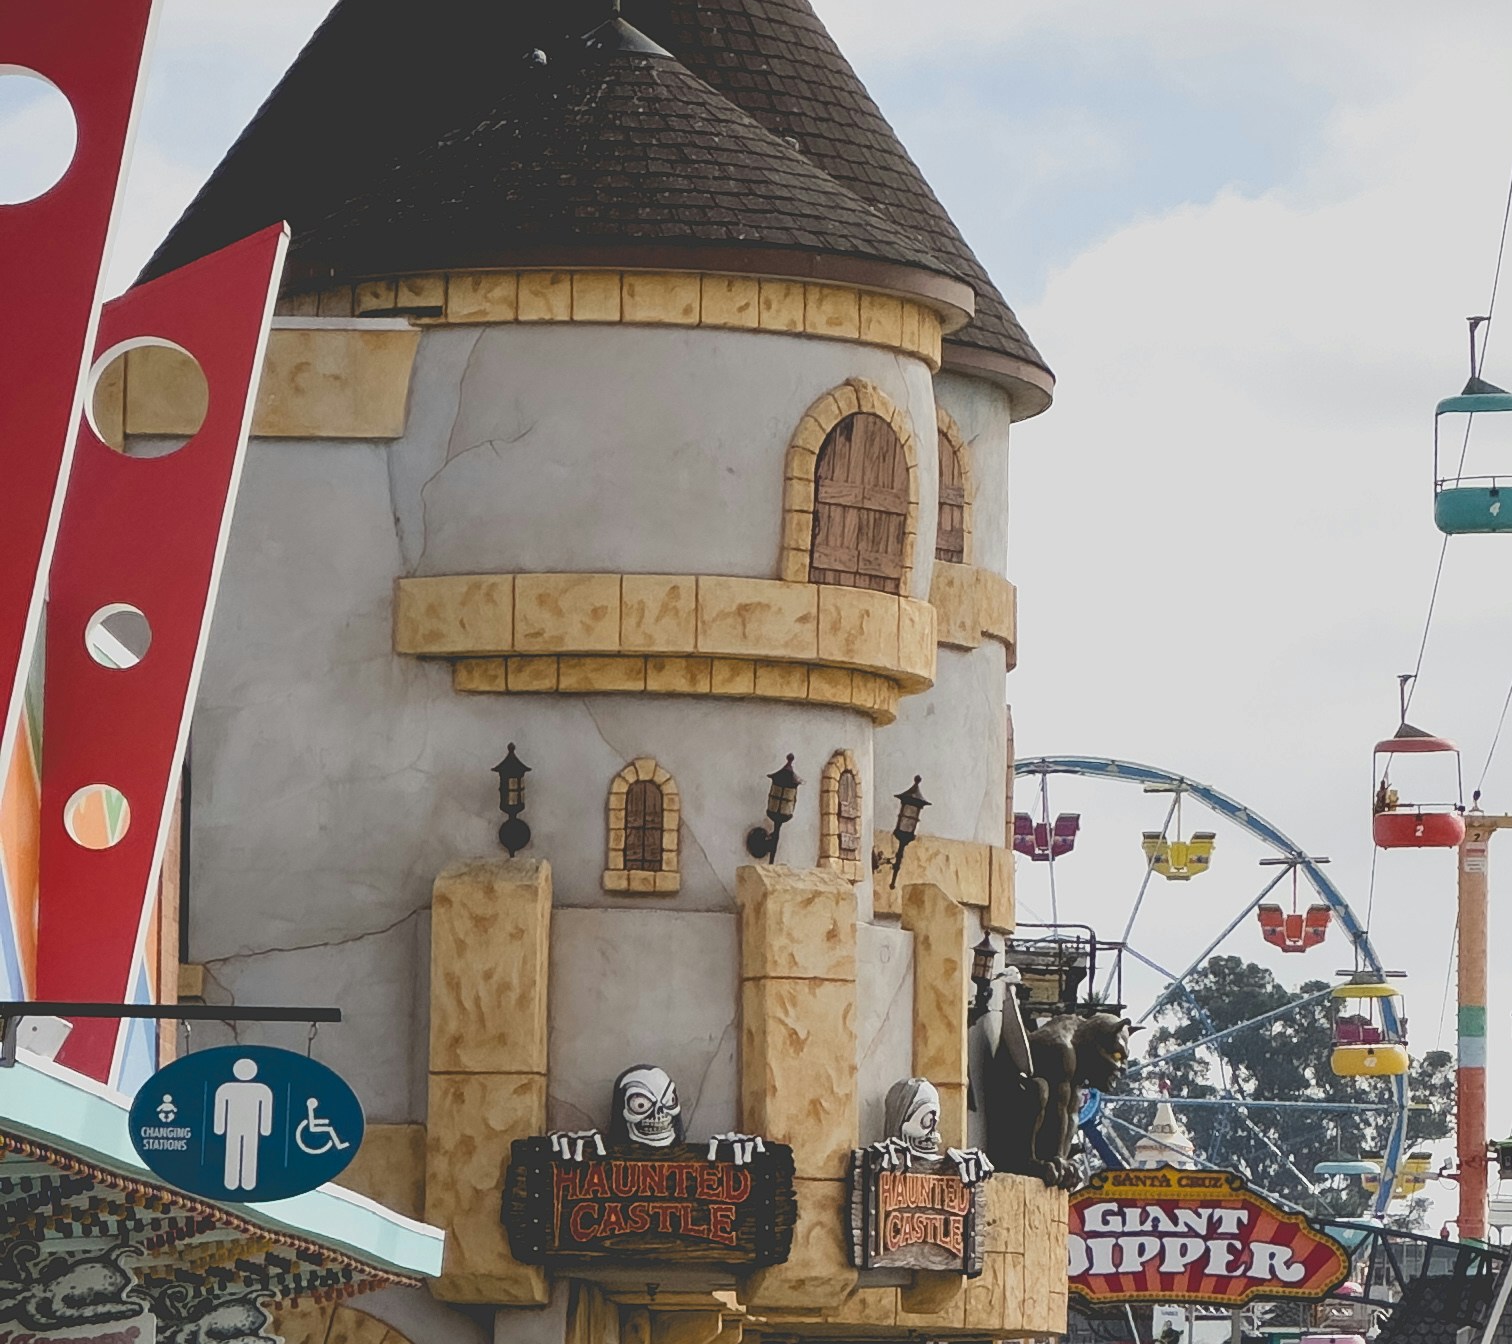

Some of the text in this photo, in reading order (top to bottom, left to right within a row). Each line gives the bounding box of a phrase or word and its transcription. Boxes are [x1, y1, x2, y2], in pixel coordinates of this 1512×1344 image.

[1415, 825, 1424, 837] 2
[141, 1126, 192, 1139] CHANGING
[143, 1139, 188, 1151] STATIONS
[551, 1161, 752, 1207] HAUNTED
[880, 1171, 970, 1216] HAUNTED
[1111, 1173, 1223, 1189] SANTA CRUZ
[570, 1202, 737, 1246] CASTLE
[887, 1211, 964, 1257] CASTLE
[1083, 1202, 1249, 1236] GIANT
